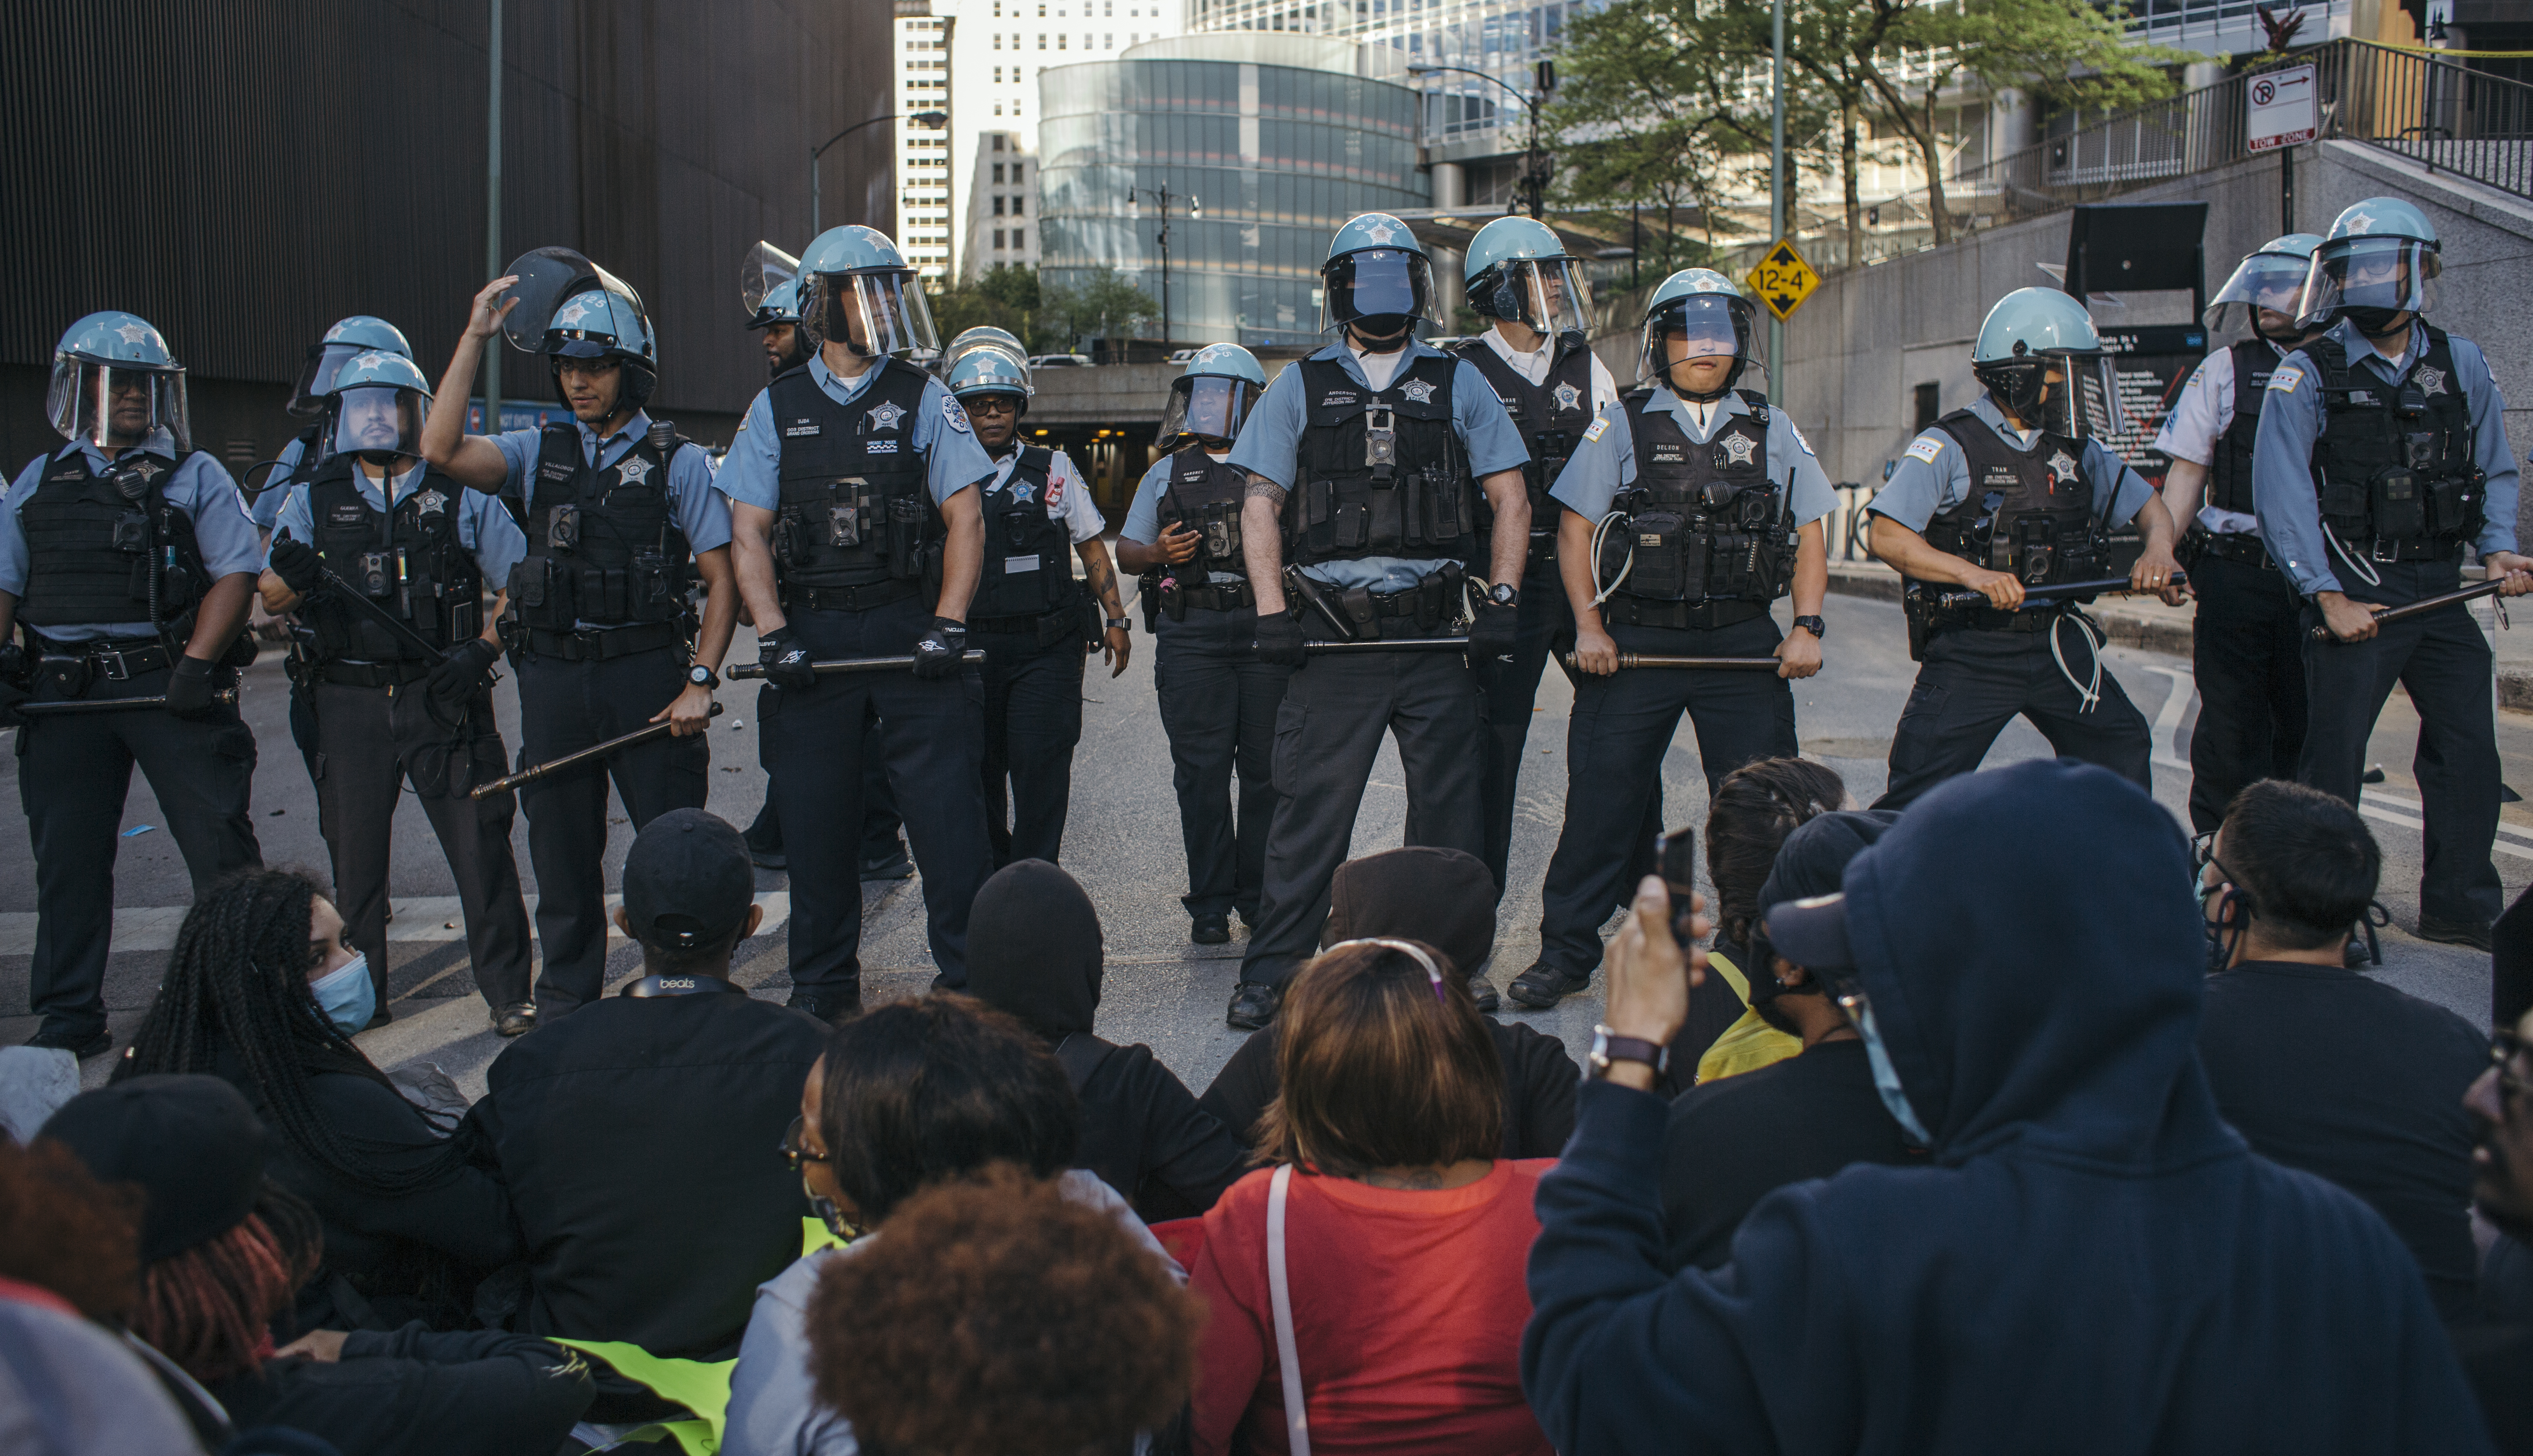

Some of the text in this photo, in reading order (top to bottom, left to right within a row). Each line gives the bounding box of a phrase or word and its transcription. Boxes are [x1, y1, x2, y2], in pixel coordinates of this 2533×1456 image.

[2254, 130, 2309, 149] TOW ZONE
[1371, 226, 1390, 235] CHICAGO
[660, 978, 695, 989] beats
